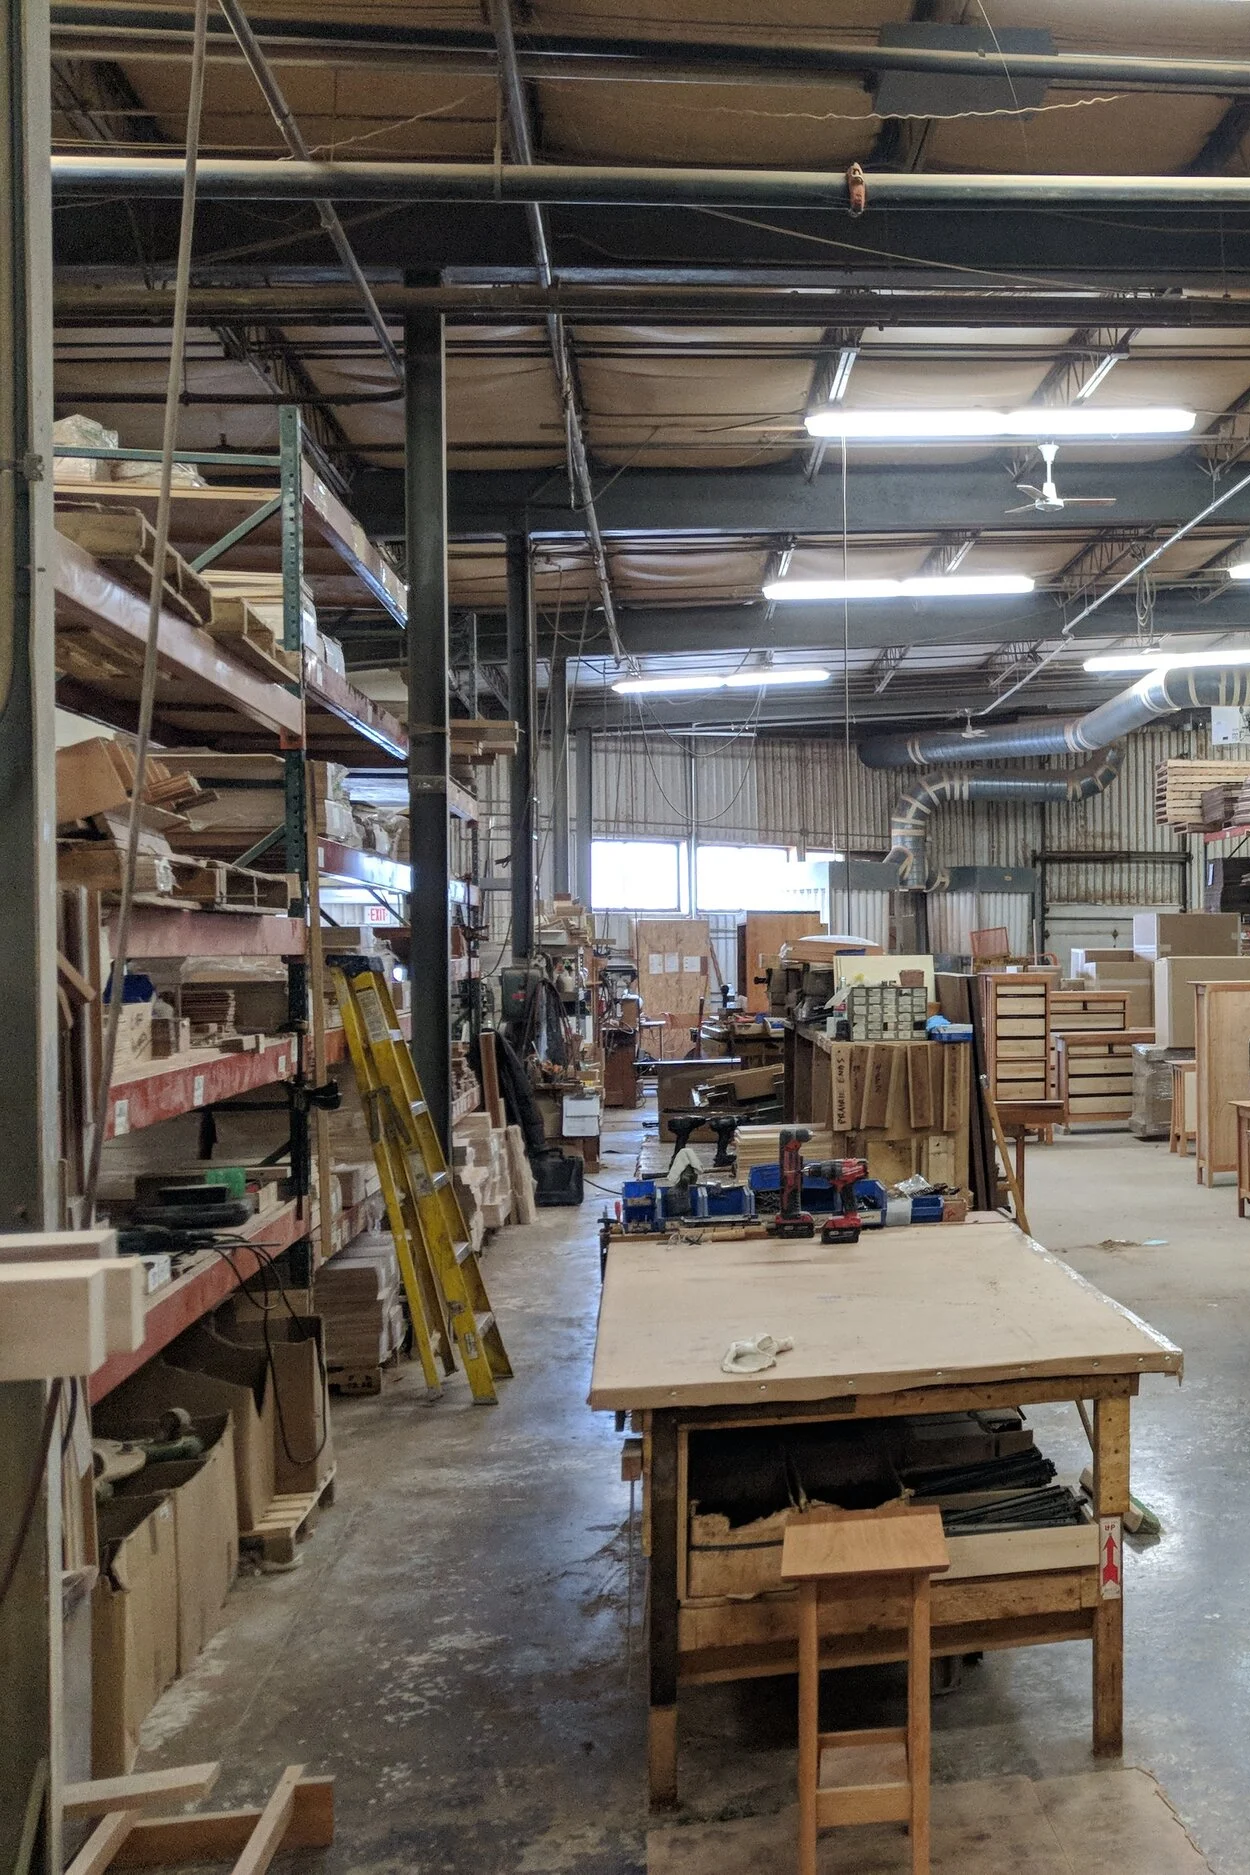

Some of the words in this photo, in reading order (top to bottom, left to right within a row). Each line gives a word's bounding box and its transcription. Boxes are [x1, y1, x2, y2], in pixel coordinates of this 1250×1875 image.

[370, 907, 386, 921] EXIT
[837, 1057, 846, 1083] ENDS
[1104, 1523, 1116, 1531] UP
